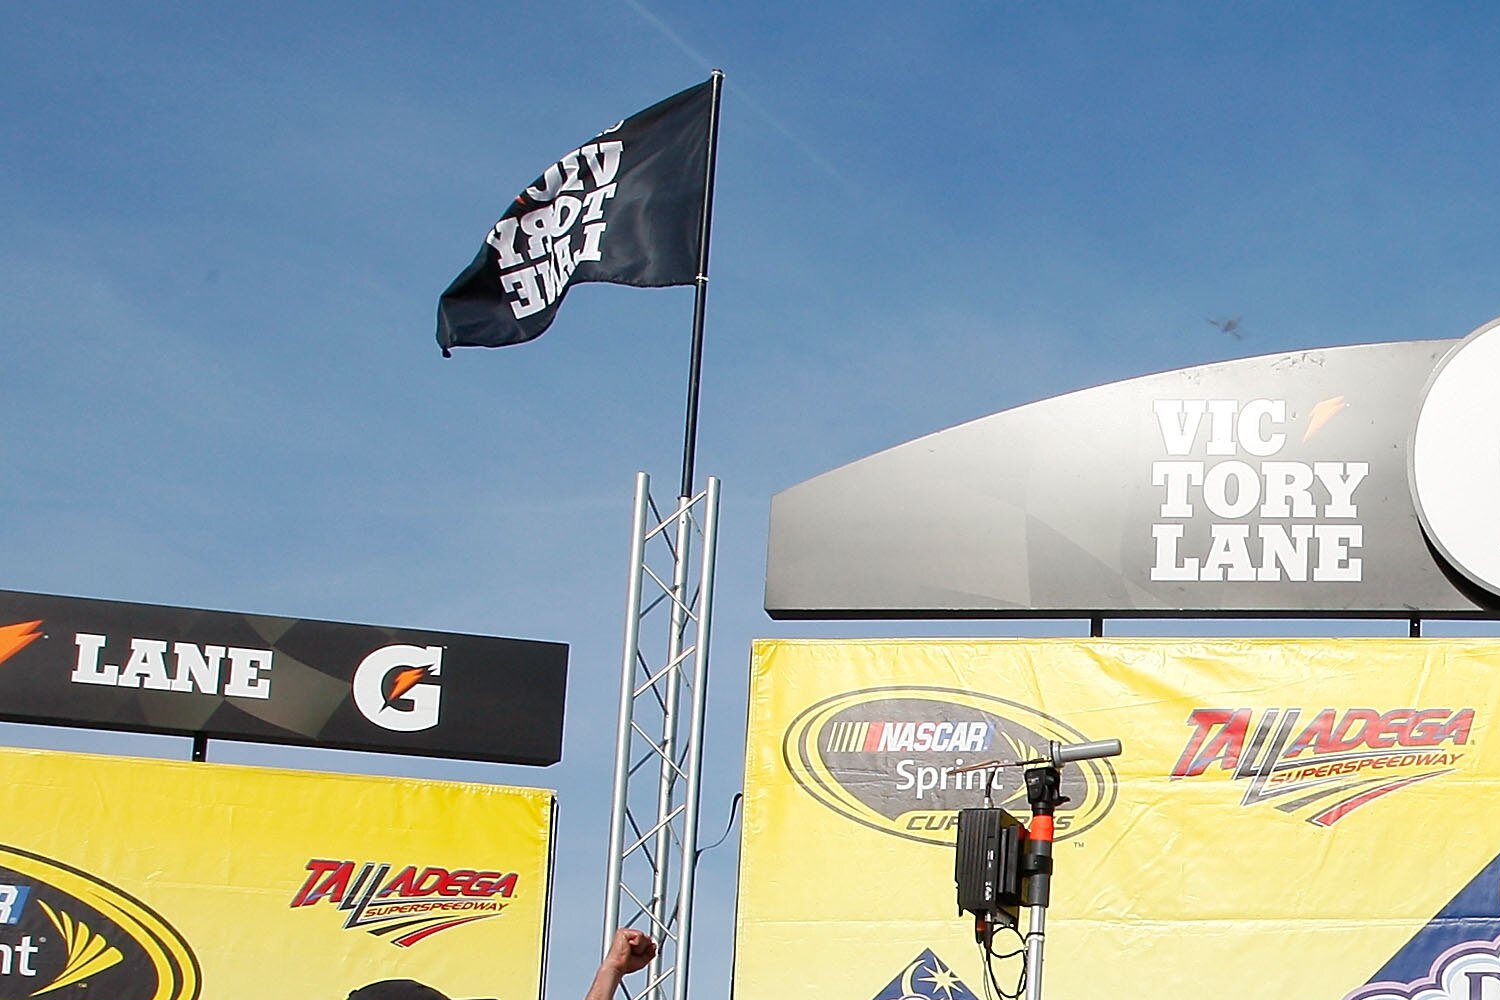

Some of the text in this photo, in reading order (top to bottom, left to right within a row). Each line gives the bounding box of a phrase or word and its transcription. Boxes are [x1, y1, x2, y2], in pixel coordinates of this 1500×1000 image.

[1152, 398, 1287, 457] VIC
[1151, 460, 1369, 519] TORY
[1150, 523, 1364, 583] LANE
[71, 633, 274, 699] LANE
[877, 720, 989, 753] NASCAR
[1169, 708, 1476, 800] TALLADEGA
[895, 759, 1005, 800] Sprint
[1270, 752, 1466, 784] SUPERSPEEDWAY
[290, 858, 519, 926] TALLADEGA
[365, 902, 510, 919] SUPERSPEEDWAY
